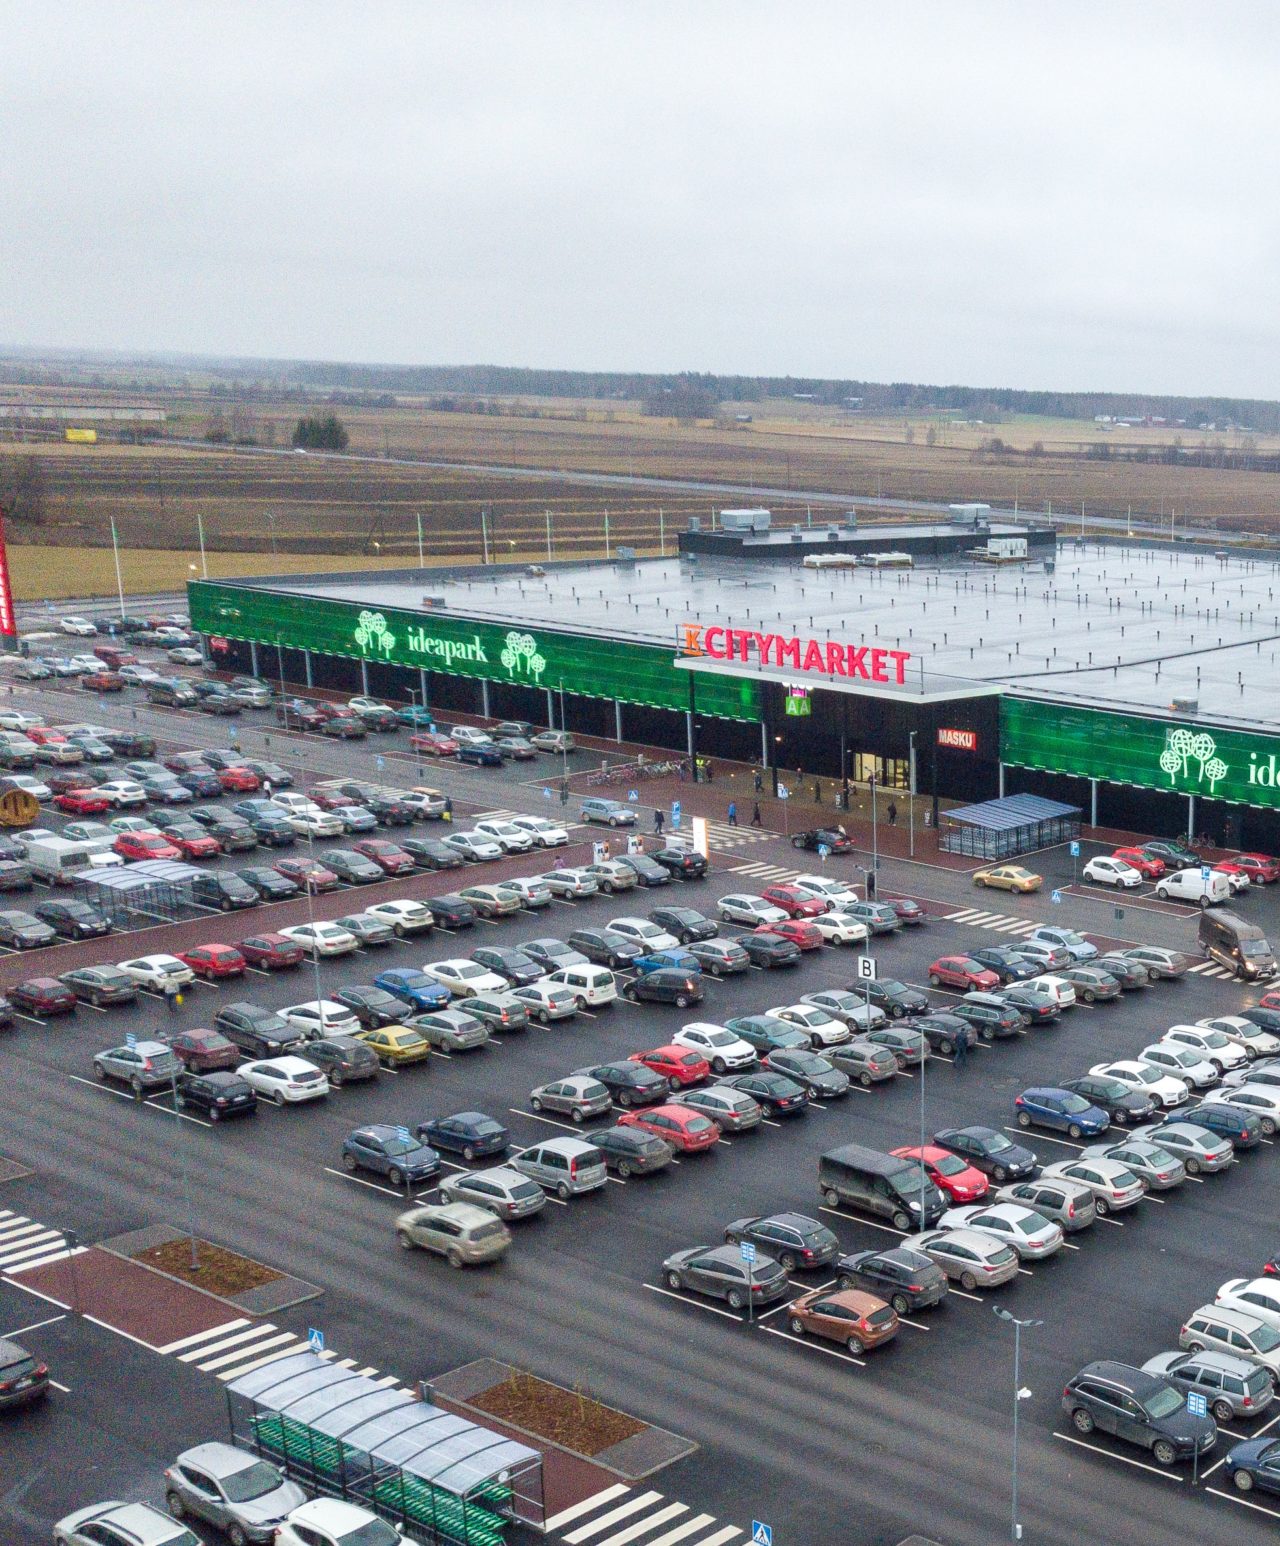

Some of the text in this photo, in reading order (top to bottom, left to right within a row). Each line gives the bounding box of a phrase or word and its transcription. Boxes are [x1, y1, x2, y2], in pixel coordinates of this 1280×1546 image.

[407, 626, 489, 666] ideapark
[704, 626, 911, 685] CITYMARKET
[788, 699, 797, 714] A
[800, 700, 809, 715] A
[938, 729, 973, 748] MASKU
[862, 959, 872, 977] B
